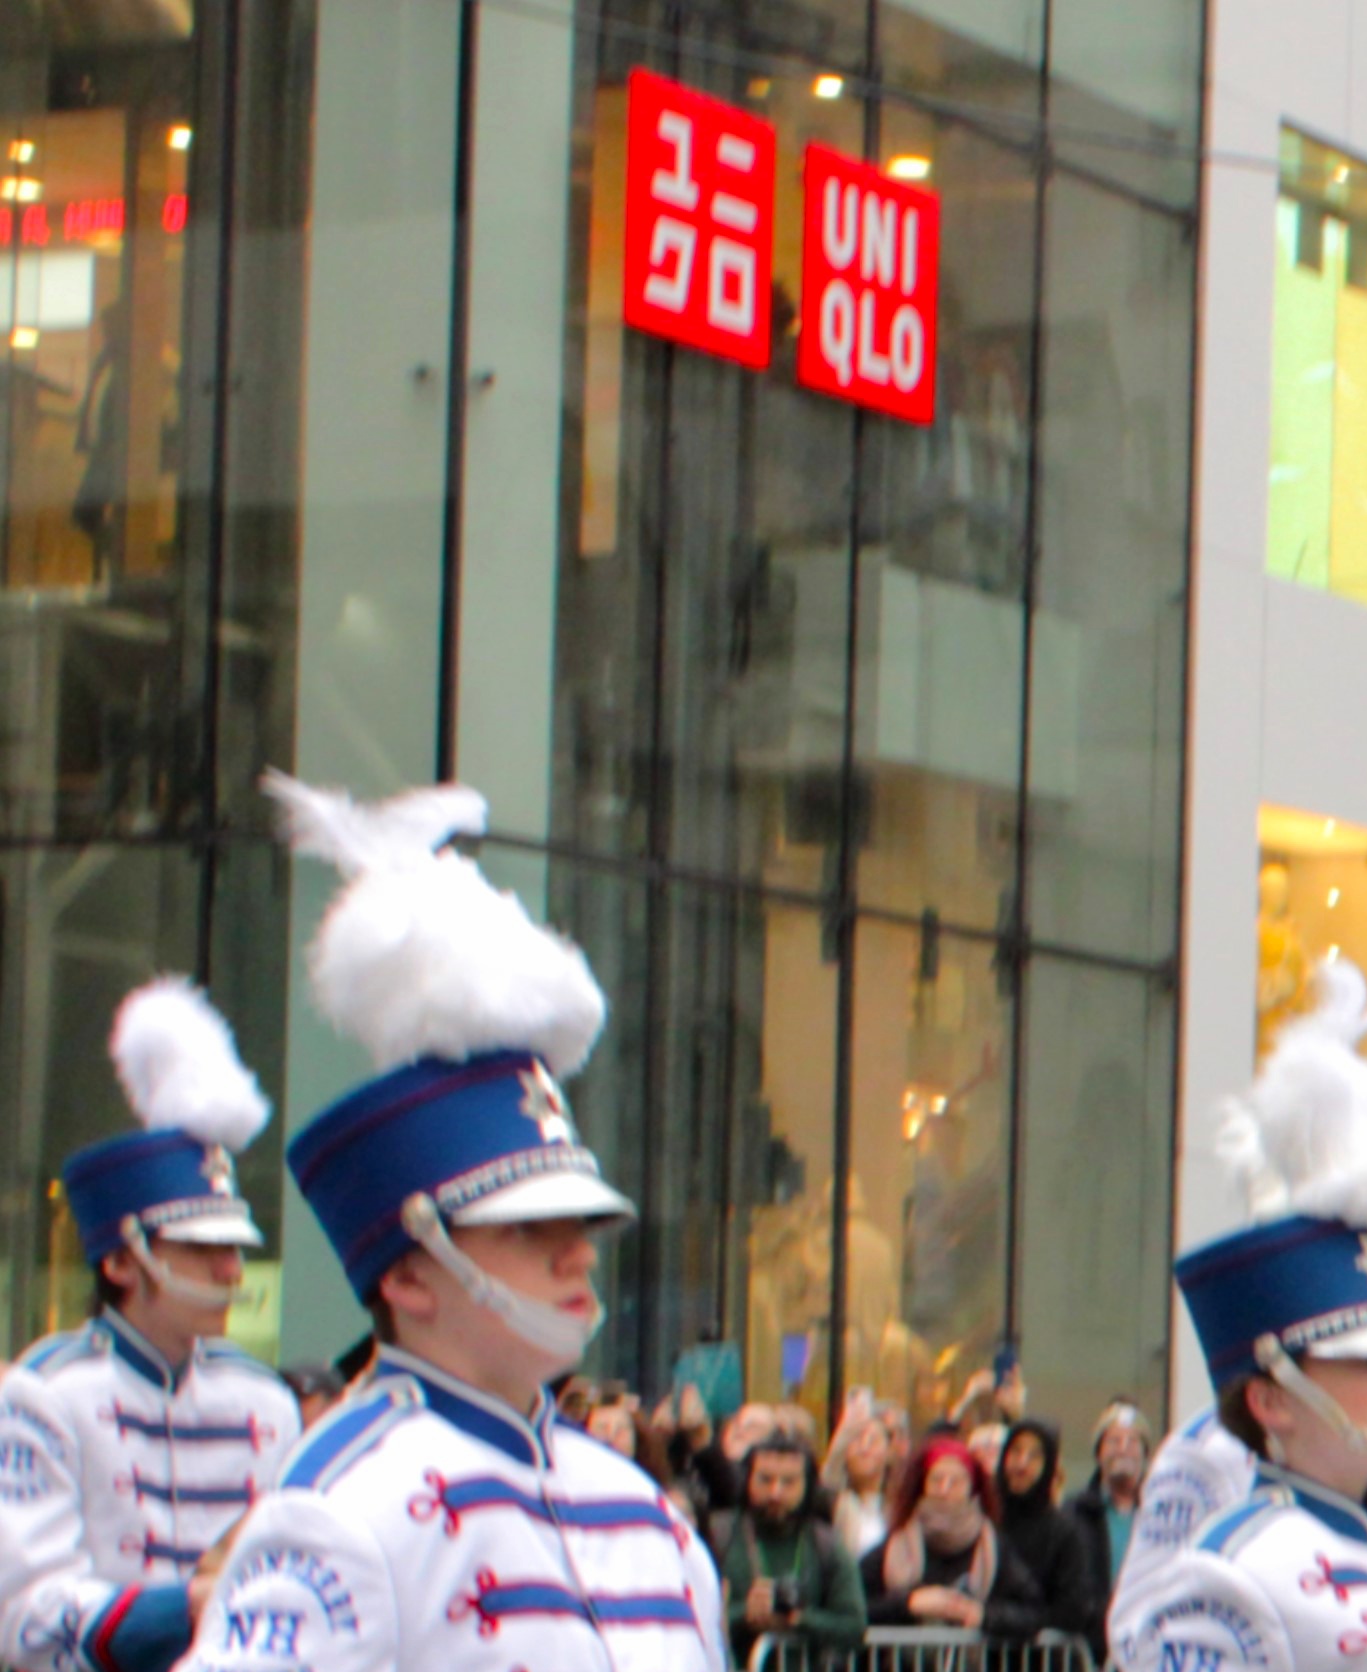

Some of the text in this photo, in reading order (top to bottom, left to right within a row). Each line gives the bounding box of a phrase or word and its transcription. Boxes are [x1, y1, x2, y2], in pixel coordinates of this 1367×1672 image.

[822, 174, 918, 297] UNI
[819, 276, 924, 394] QLO
[225, 1609, 306, 1657] NH
